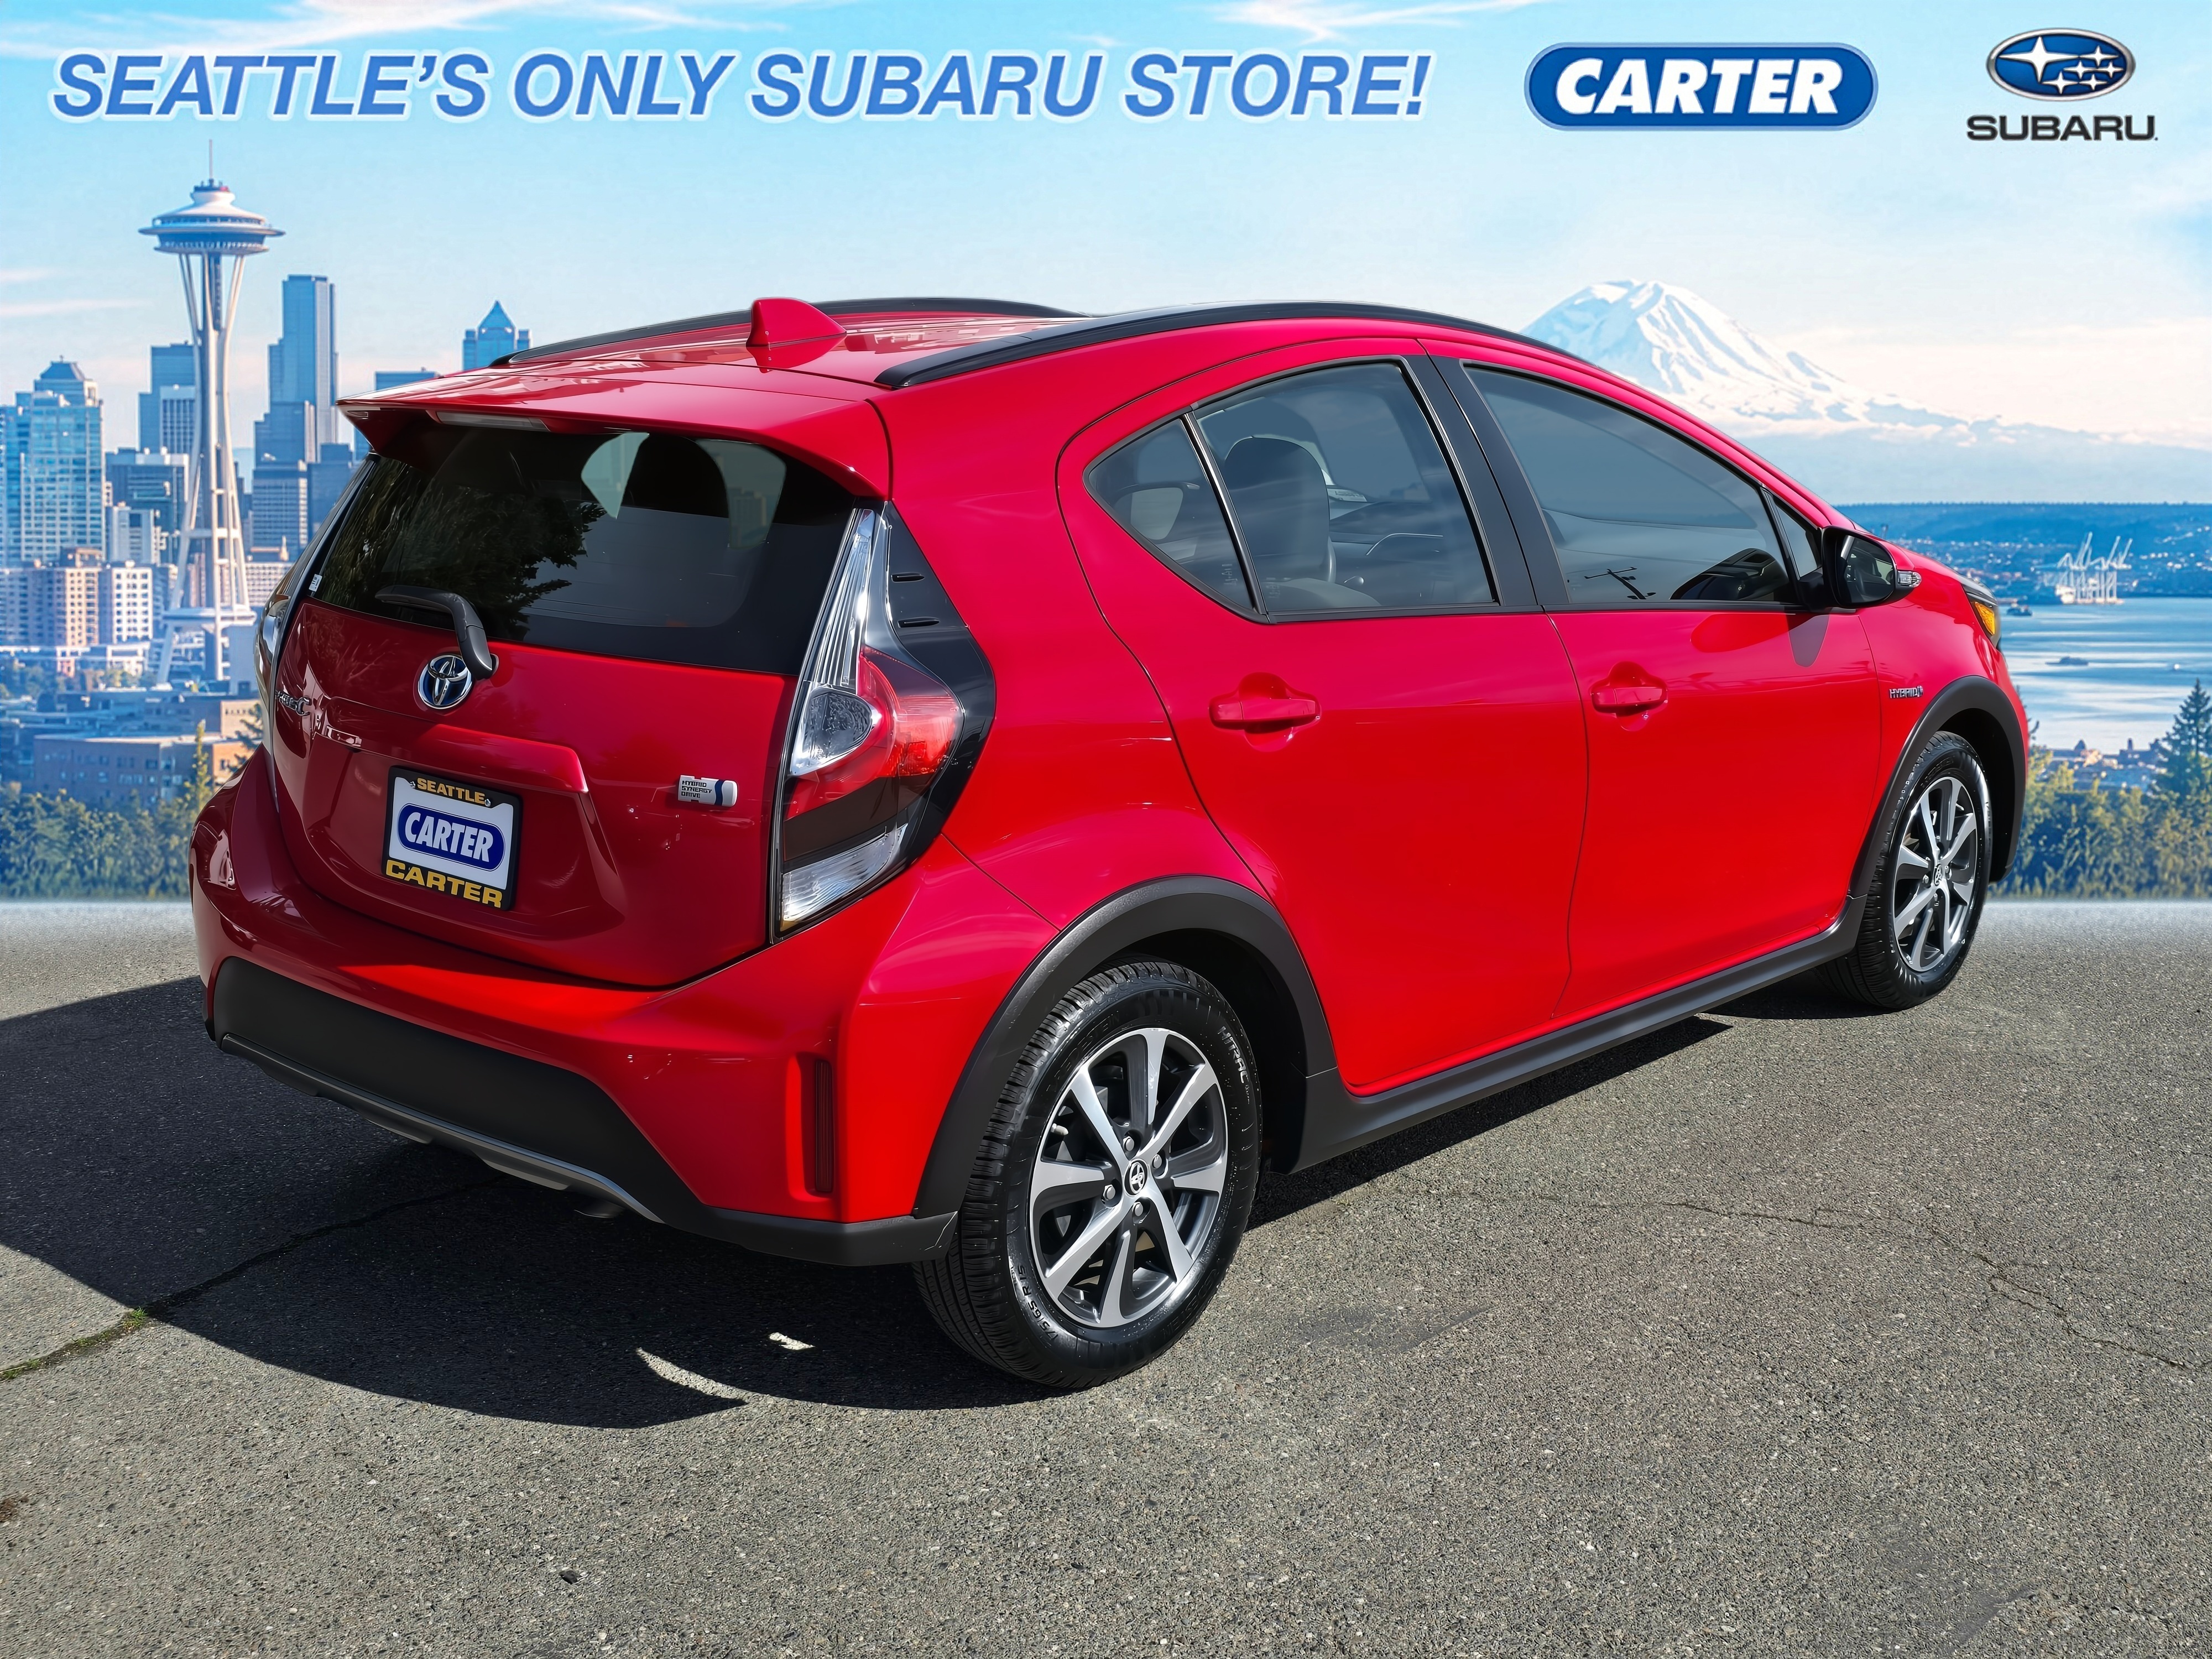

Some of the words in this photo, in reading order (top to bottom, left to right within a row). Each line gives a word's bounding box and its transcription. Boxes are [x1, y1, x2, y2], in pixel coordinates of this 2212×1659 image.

[416, 777, 486, 805] SEATTLE
[404, 811, 494, 863] CARTER
[385, 859, 503, 909] CARTER
